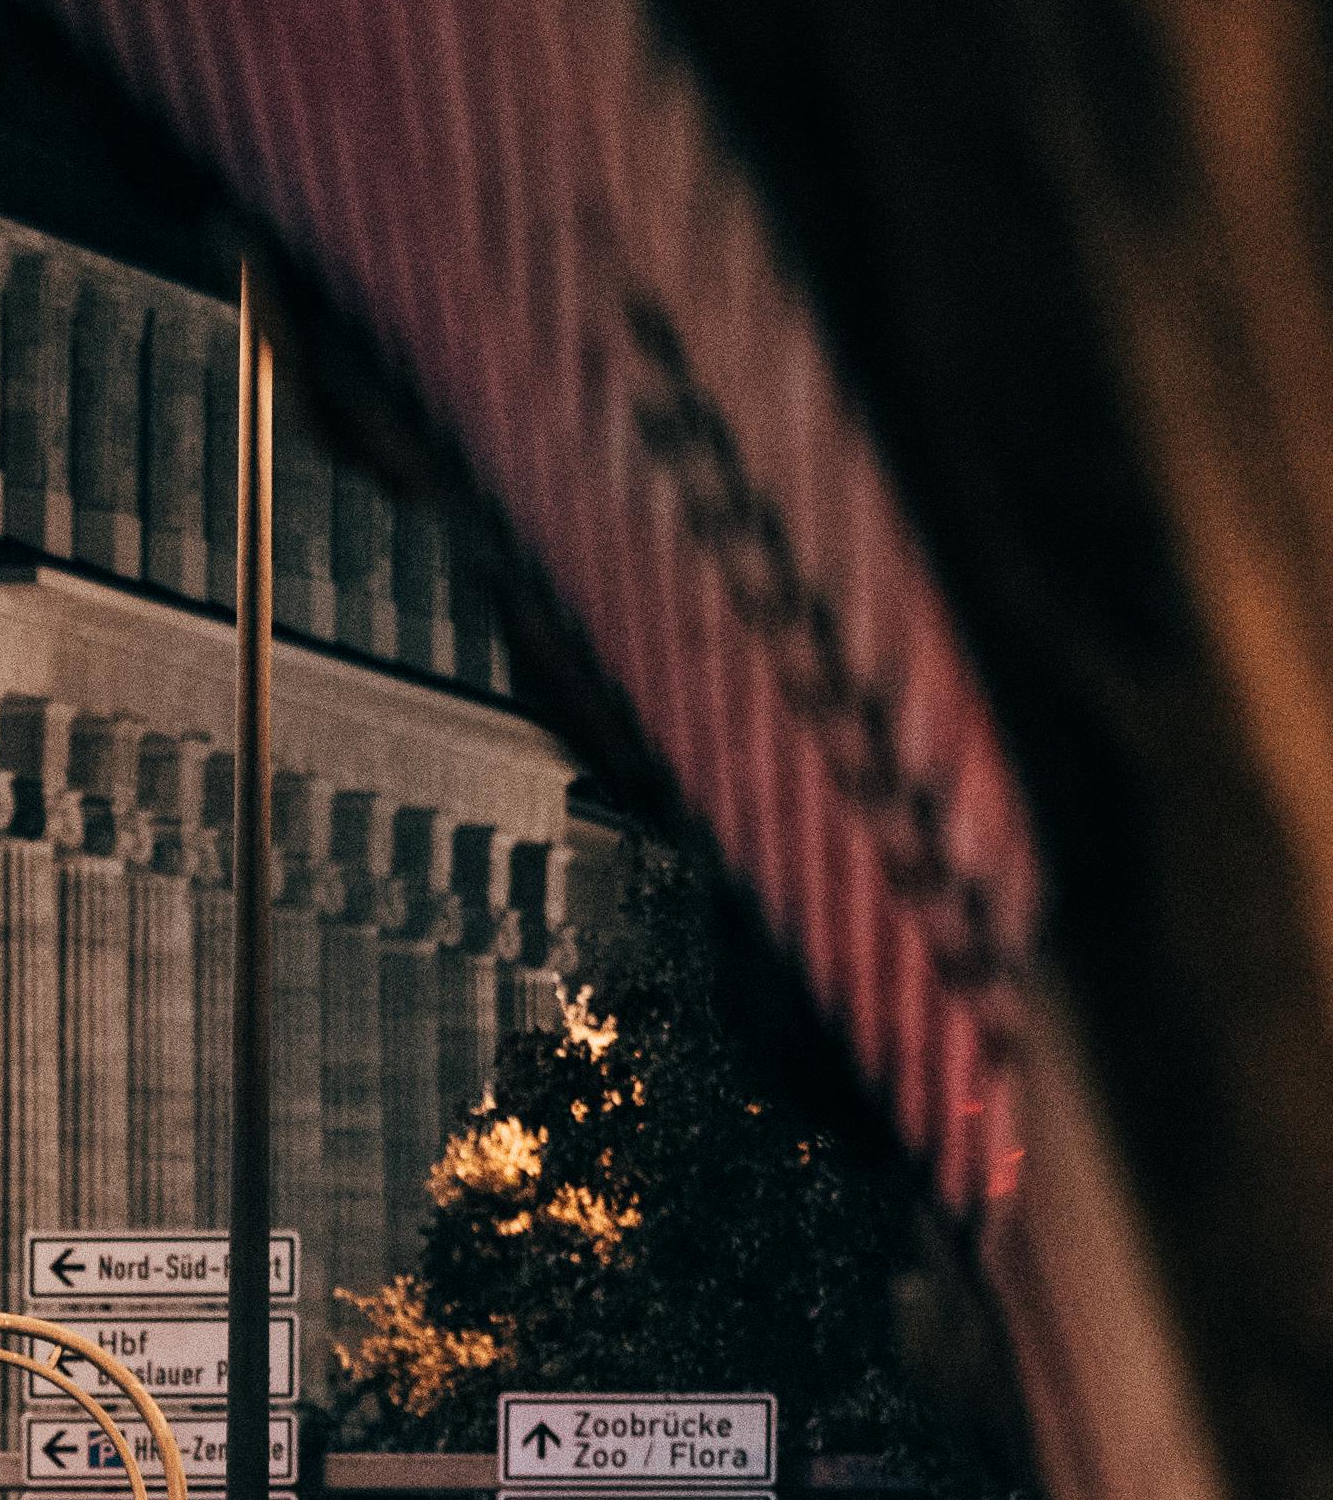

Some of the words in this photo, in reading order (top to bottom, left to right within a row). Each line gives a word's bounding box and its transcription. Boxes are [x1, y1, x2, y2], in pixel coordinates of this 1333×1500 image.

[98, 1330, 148, 1356] Hbf
[574, 1411, 733, 1438] Zoobrücke
[574, 1441, 627, 1468] Zoo
[669, 1441, 748, 1468] Flora
